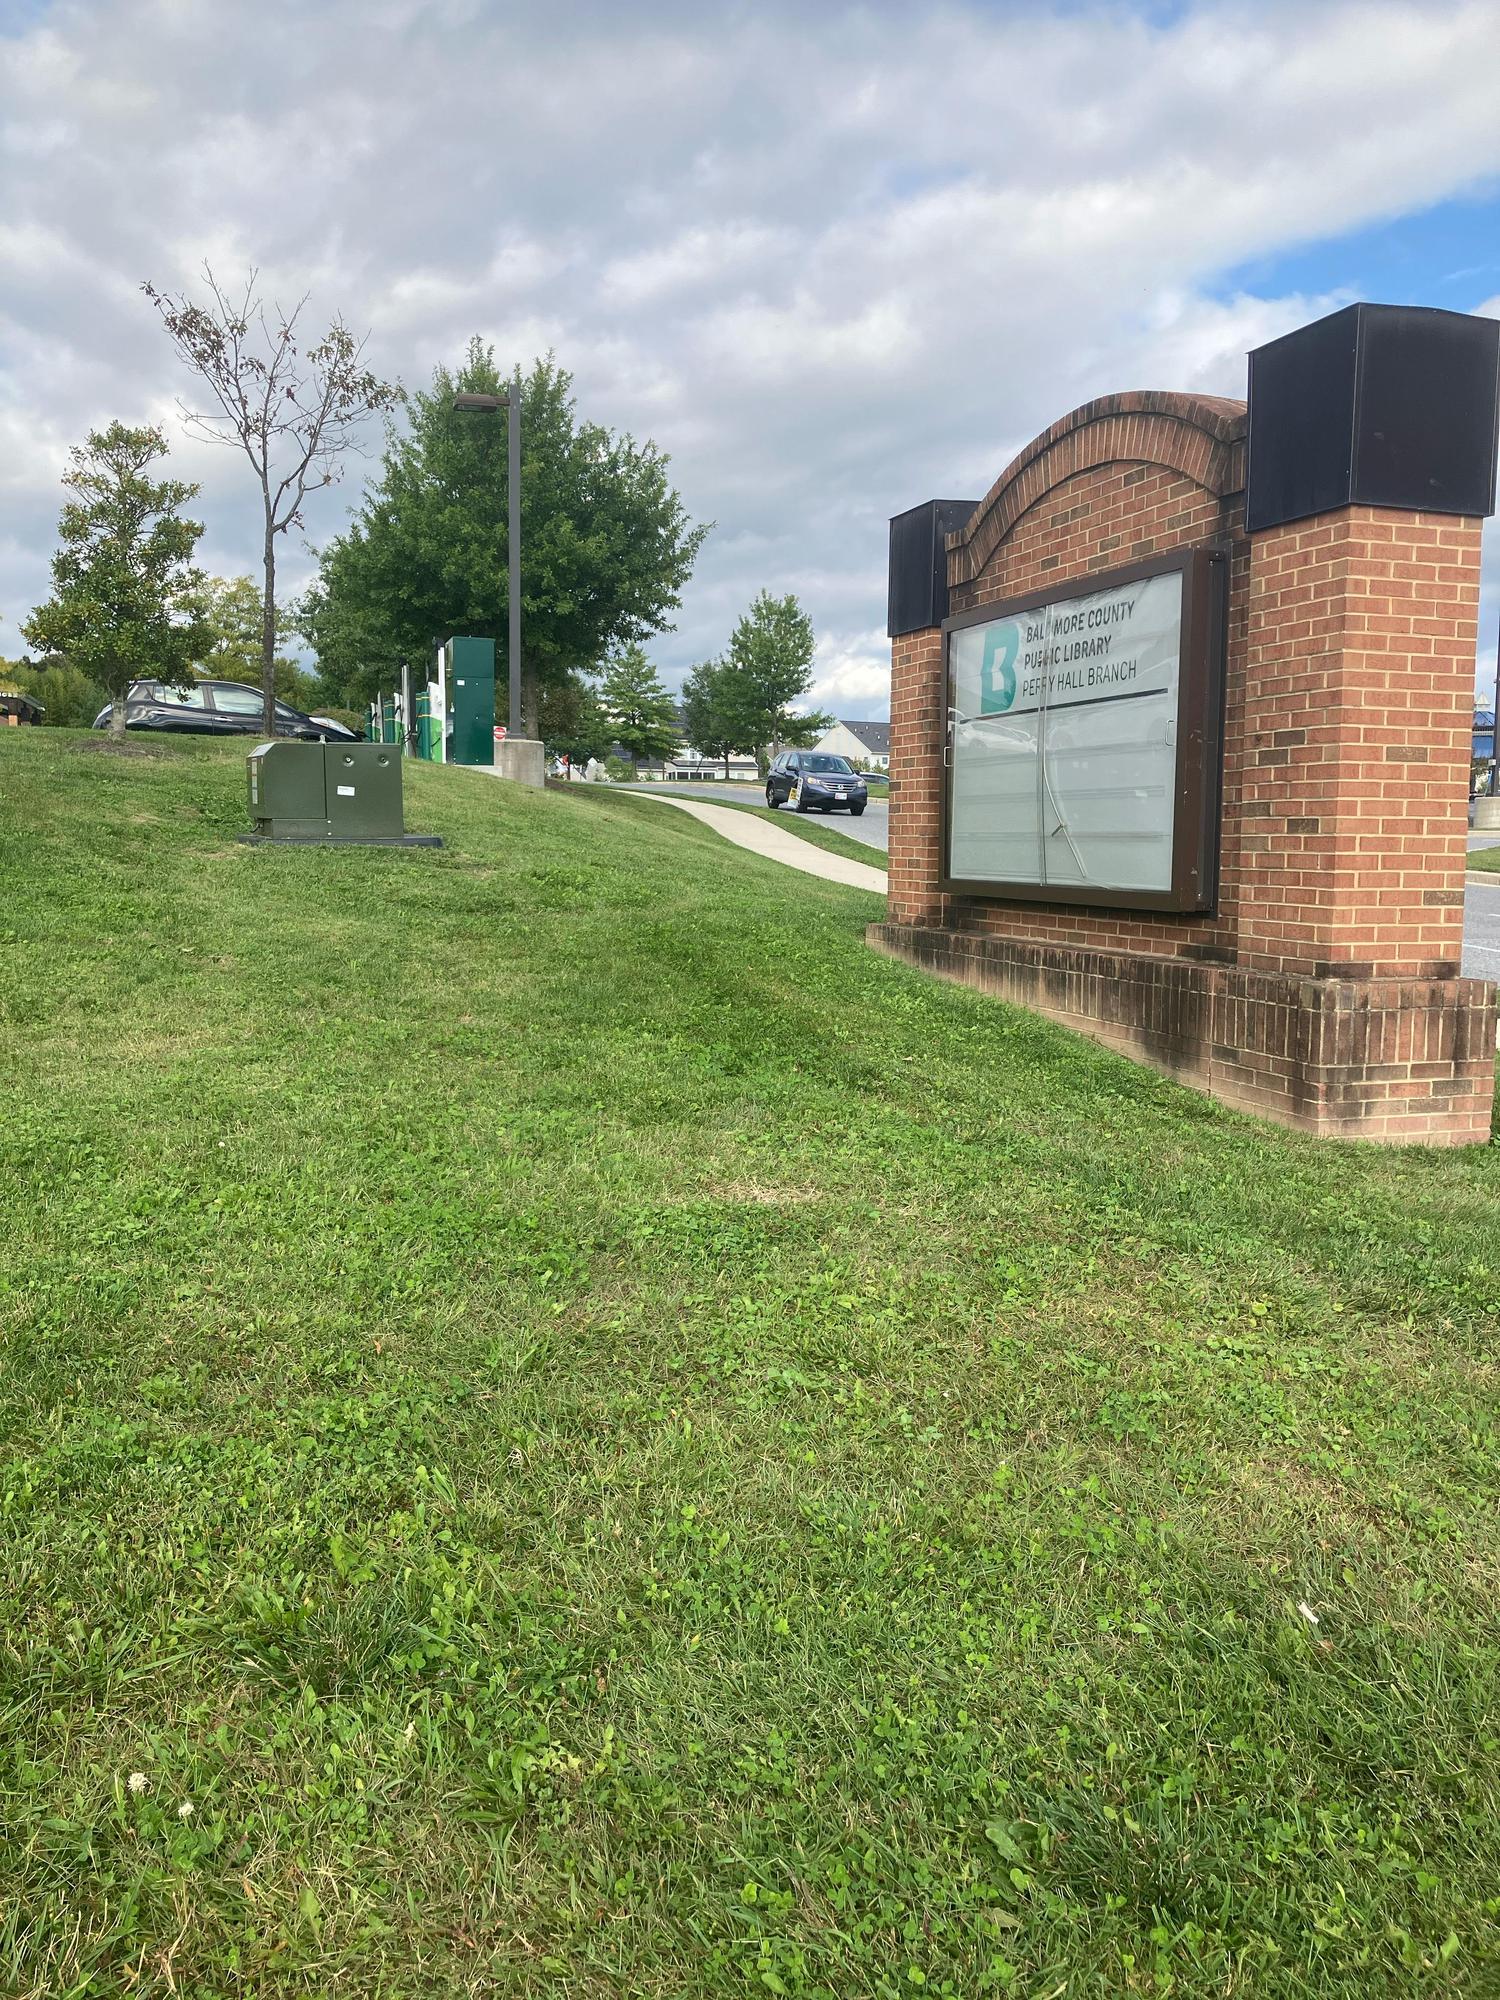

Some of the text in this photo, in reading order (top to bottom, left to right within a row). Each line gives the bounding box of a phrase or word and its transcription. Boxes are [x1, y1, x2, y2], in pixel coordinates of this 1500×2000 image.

[1026, 600, 1135, 643] BALMORE COUNTY
[1063, 635, 1112, 662] LIBRARY
[1057, 670, 1085, 691] HALL
[1088, 659, 1137, 686] BRANCH
